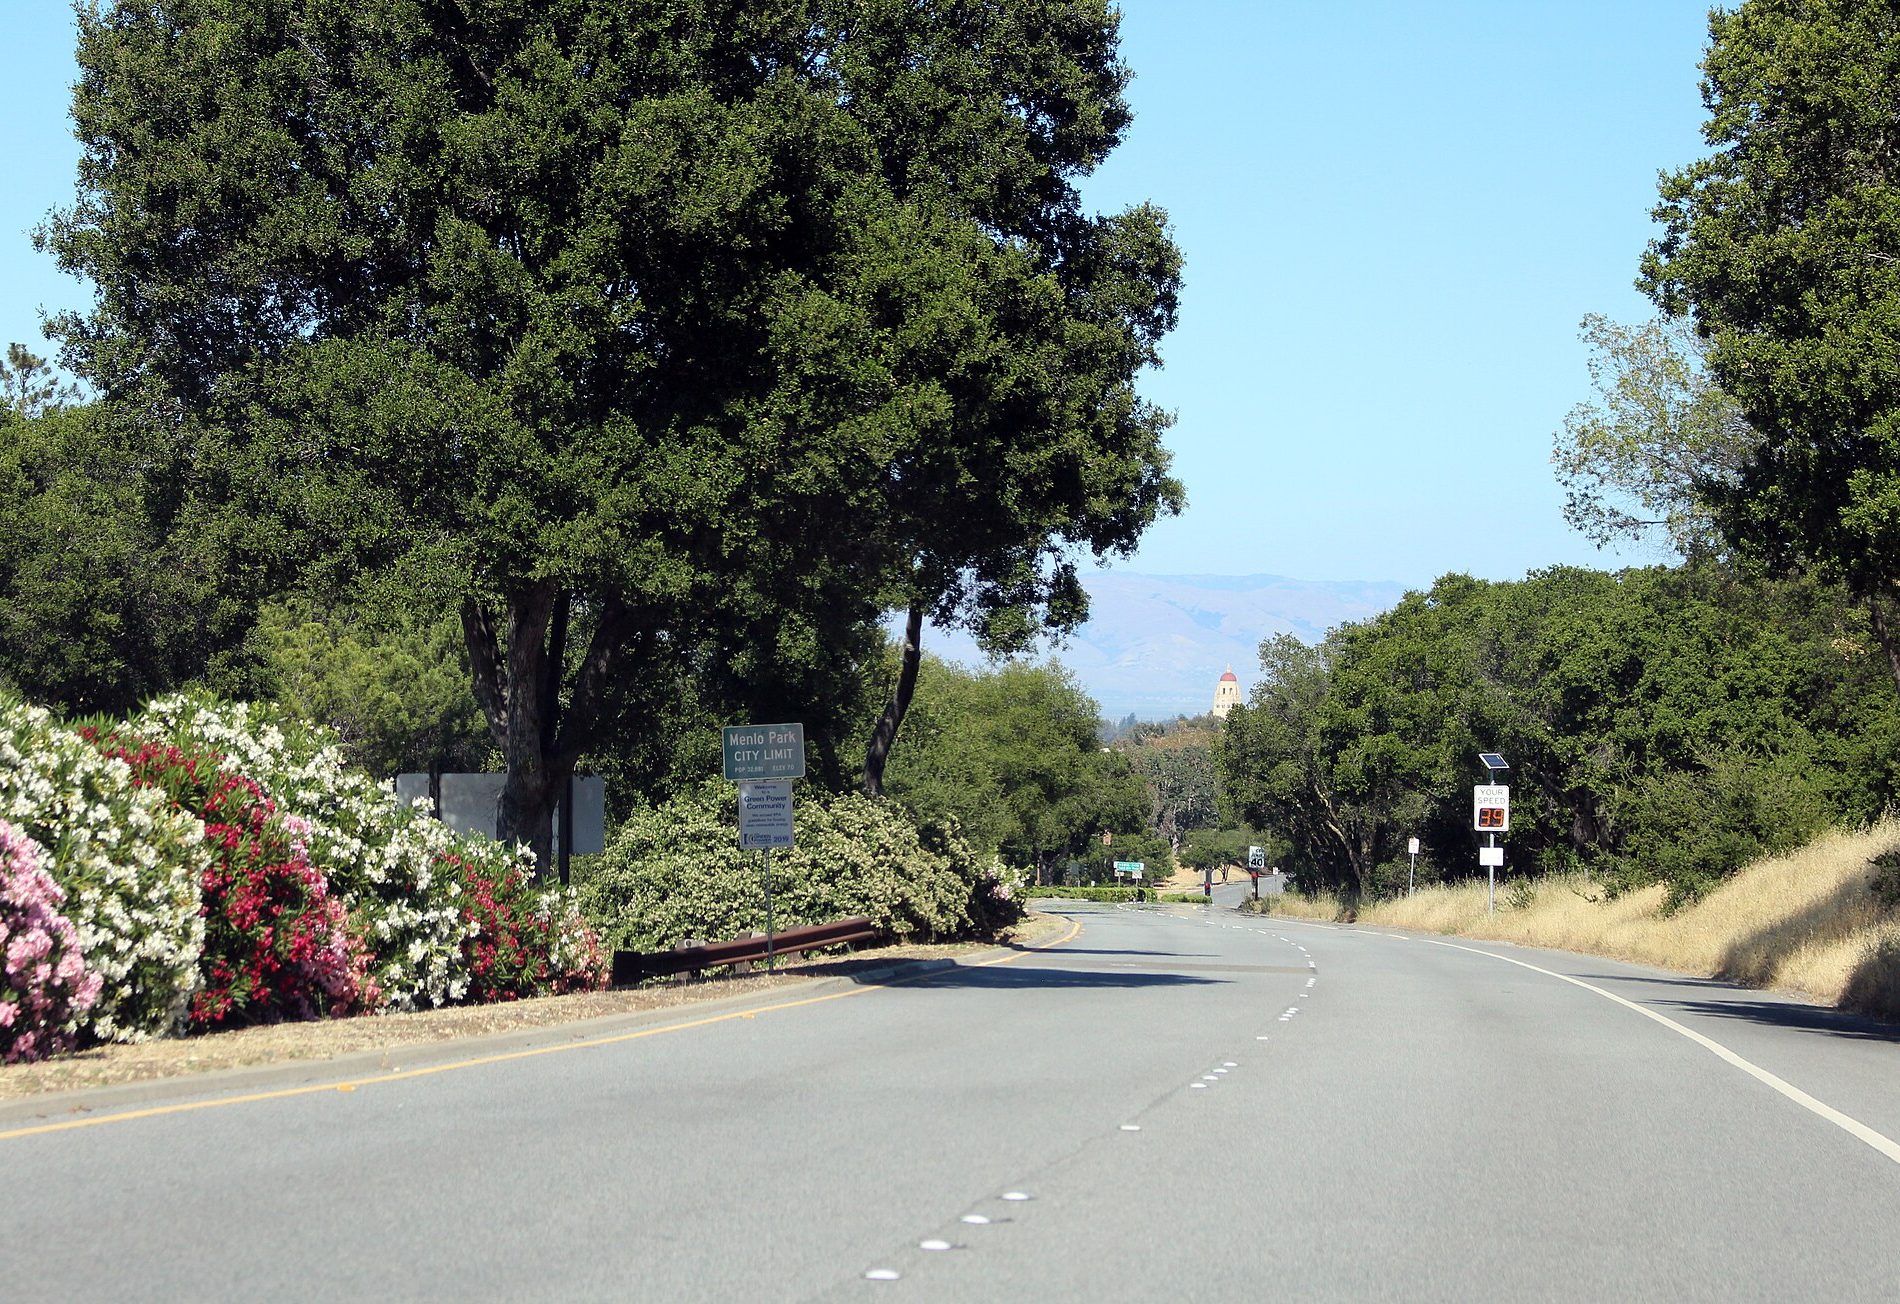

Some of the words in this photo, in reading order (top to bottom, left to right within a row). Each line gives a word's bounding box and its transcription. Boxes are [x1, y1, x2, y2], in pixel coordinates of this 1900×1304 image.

[729, 733, 764, 746] Menlo
[768, 731, 796, 744] Park
[734, 750, 760, 762] CITY
[763, 748, 793, 760] LIMIT
[1480, 788, 1504, 796] YOUR
[744, 795, 765, 803] Green
[746, 802, 786, 810] Community
[1480, 809, 1504, 827] 39
[1251, 858, 1263, 867] 40
